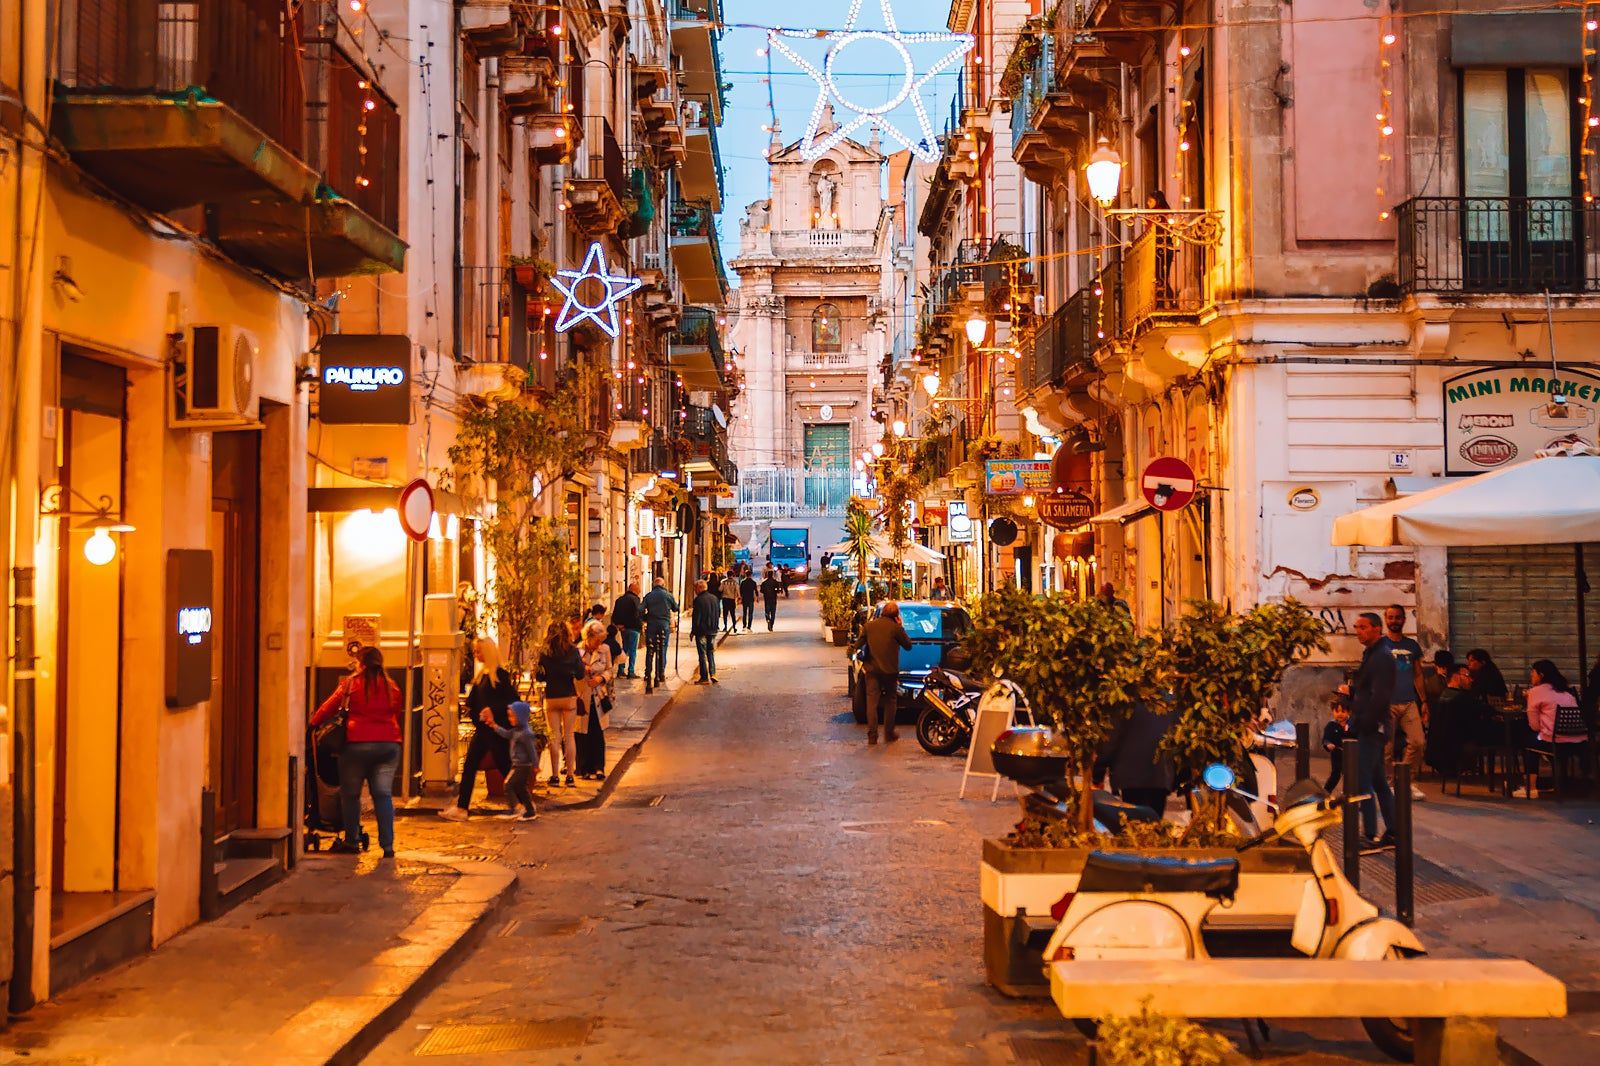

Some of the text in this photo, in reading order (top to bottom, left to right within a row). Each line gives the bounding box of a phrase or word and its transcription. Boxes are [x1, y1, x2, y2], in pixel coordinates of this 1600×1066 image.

[325, 366, 404, 385] PALINURO
[1448, 377, 1600, 404] MINI MARKET
[1395, 454, 1404, 463] 62
[1042, 504, 1091, 517] LA SALAMERIA
